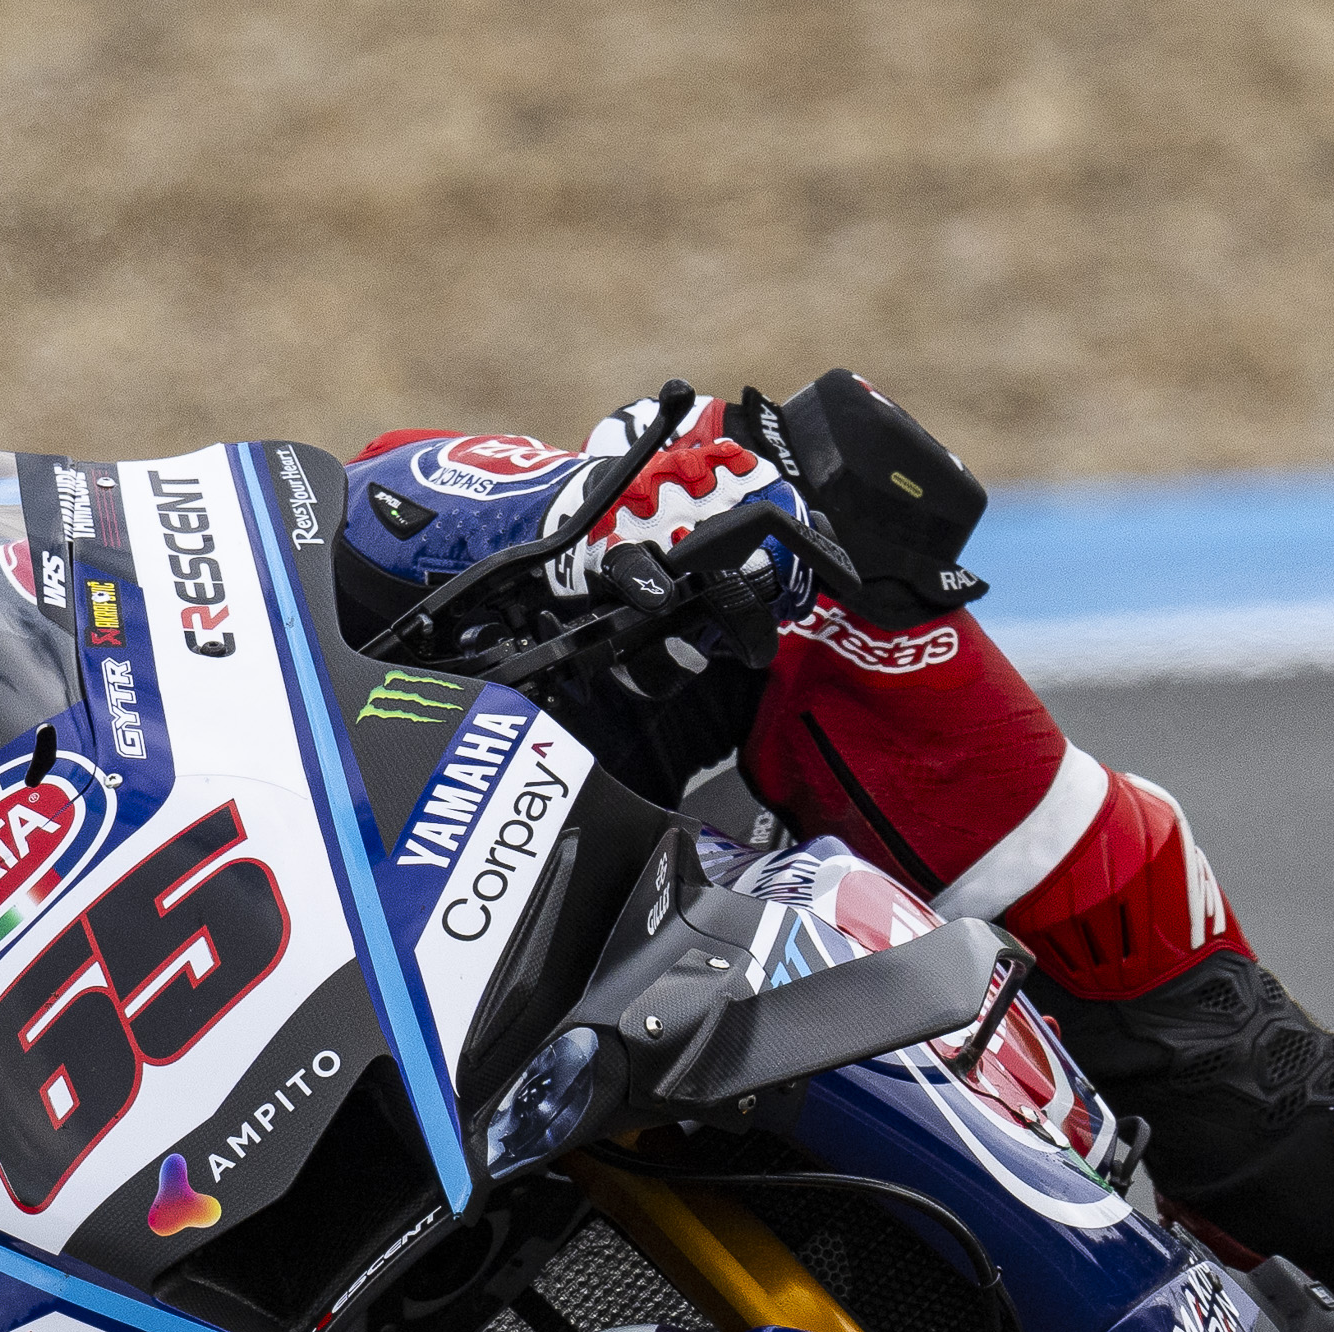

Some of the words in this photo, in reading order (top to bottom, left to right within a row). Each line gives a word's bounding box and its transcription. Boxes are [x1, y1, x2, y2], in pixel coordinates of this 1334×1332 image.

[759, 403, 800, 477] AHEAD
[42, 551, 66, 608] WRS
[147, 470, 237, 658] CRESCENT
[101, 657, 147, 760] GYTR
[396, 713, 528, 869] YAMAHA
[441, 761, 569, 943] Corpay
[206, 1050, 341, 1184] AMPITO
